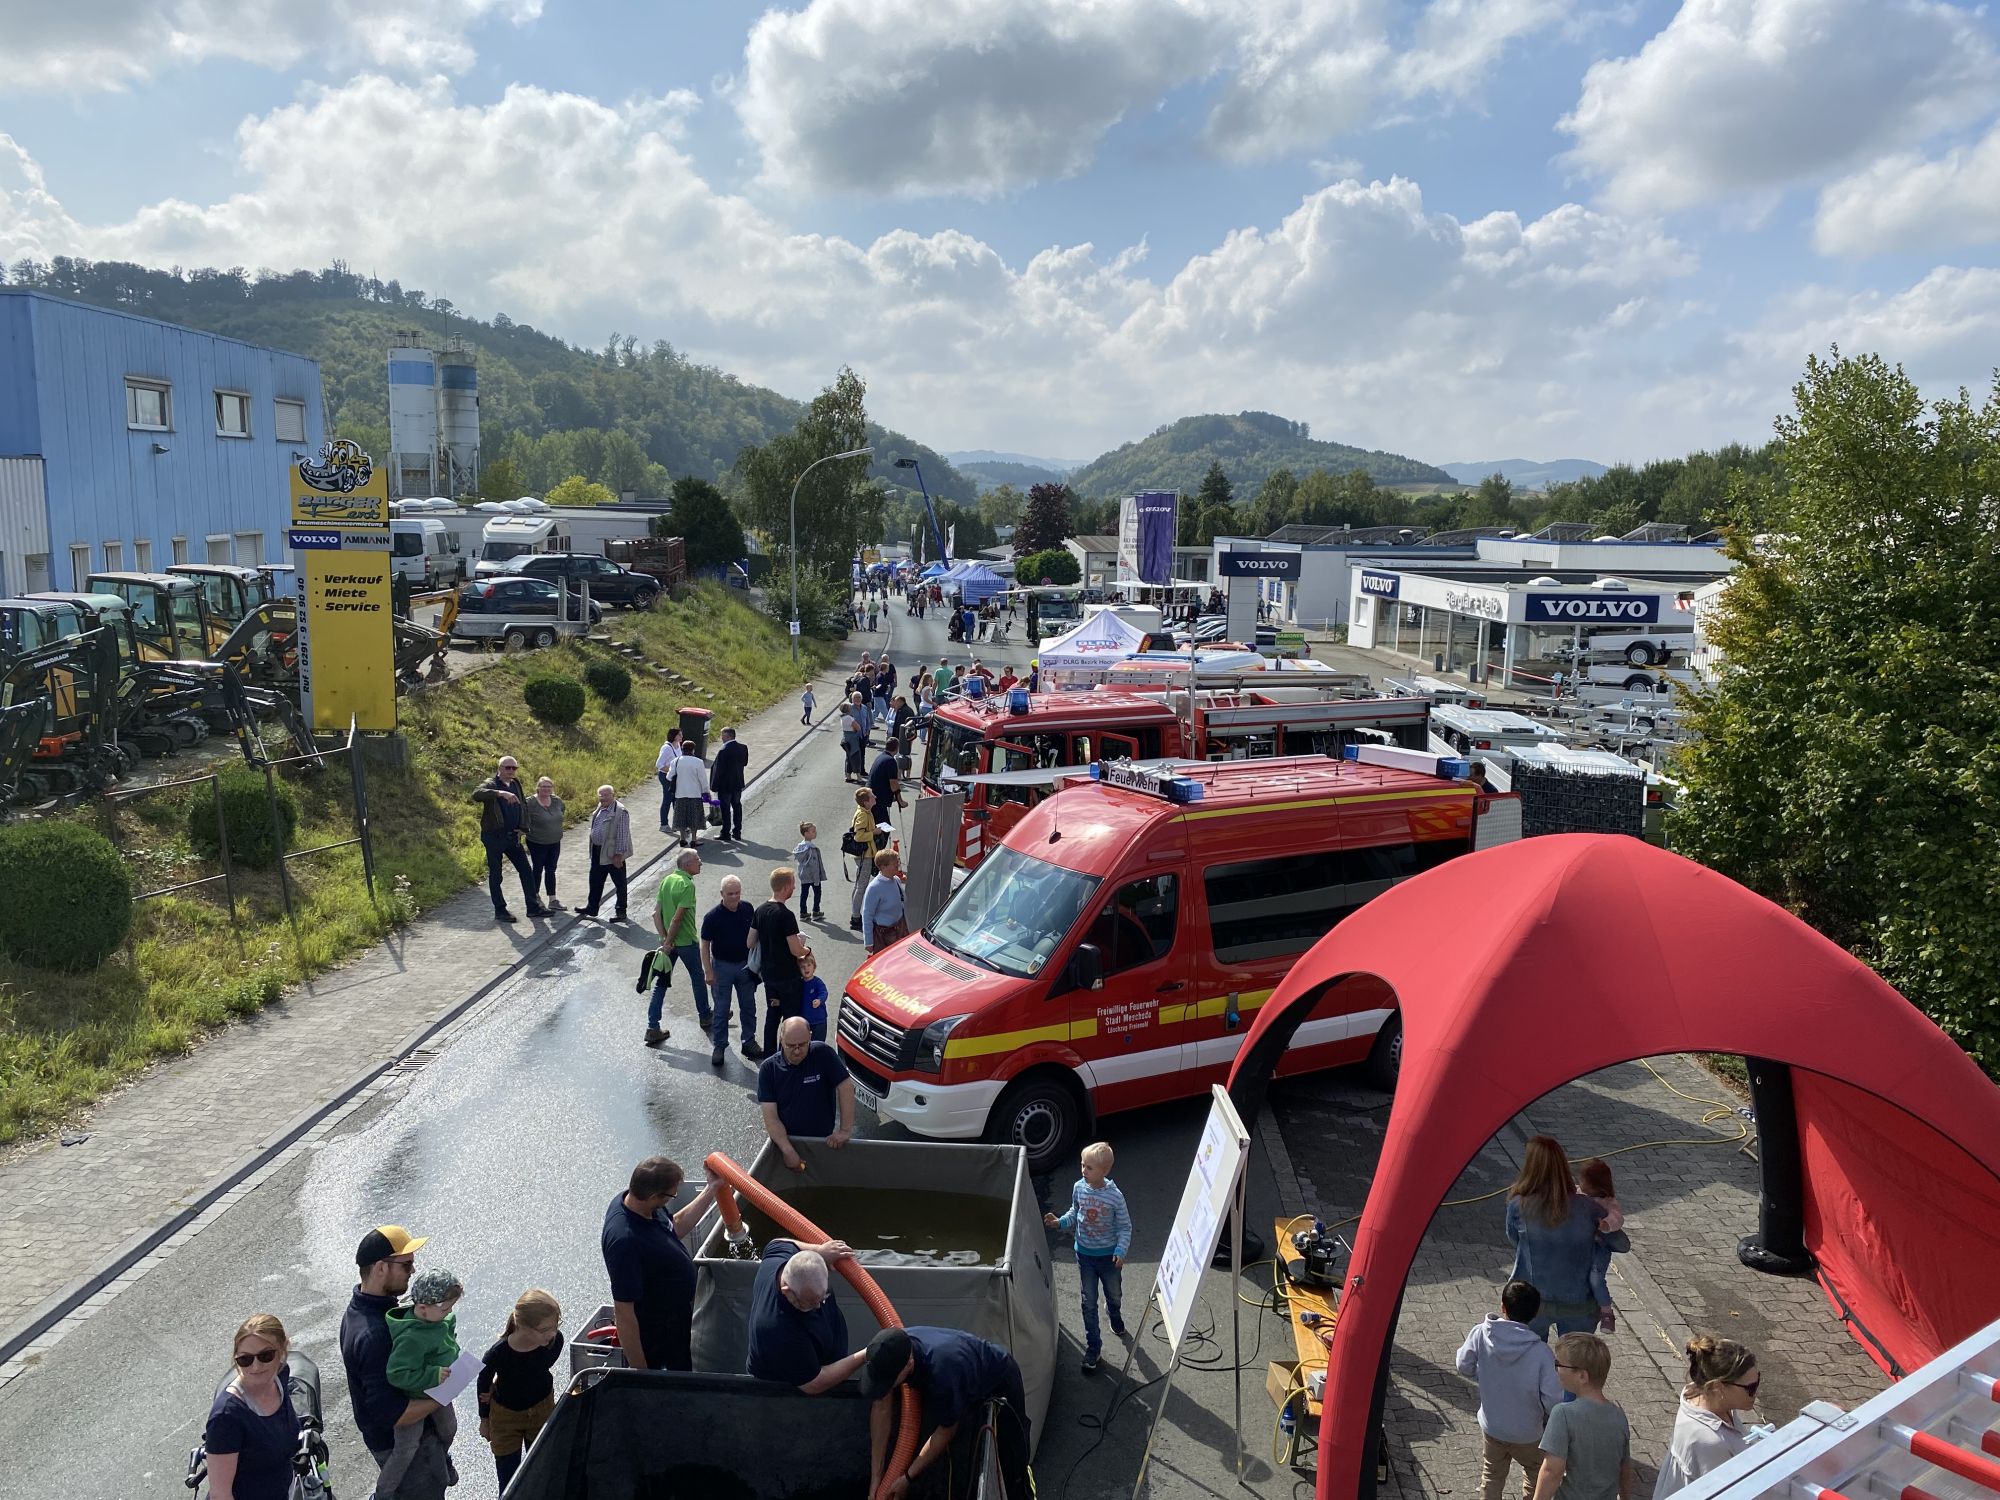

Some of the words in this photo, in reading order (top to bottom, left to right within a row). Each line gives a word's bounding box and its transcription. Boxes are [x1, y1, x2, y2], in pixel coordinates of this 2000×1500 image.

[298, 495, 381, 508] BAGGER
[296, 520, 384, 528] Baumaschinenvermietung
[291, 535, 339, 544] VOLVO
[344, 535, 390, 545] AMMANN
[1236, 560, 1289, 570] VOLVO
[297, 577, 305, 591] 40
[323, 574, 384, 585] Verkauf
[1362, 575, 1394, 593] VOLVO
[324, 588, 368, 598] Miete
[298, 594, 306, 608] 90
[324, 602, 381, 612] Service
[1540, 599, 1649, 618] VOLVO
[299, 610, 307, 624] 52
[300, 642, 309, 666] 0291
[302, 674, 310, 693] Ruf
[166, 706, 189, 719] VOLVO
[1109, 770, 1158, 792] Feuerwehr
[854, 967, 932, 1016] Feuerwehr
[1096, 1004, 1128, 1017] Freiwillige
[1129, 999, 1160, 1011] Feuerwehr
[1105, 1015, 1121, 1026] Stadt
[1123, 1011, 1152, 1023] Meschede
